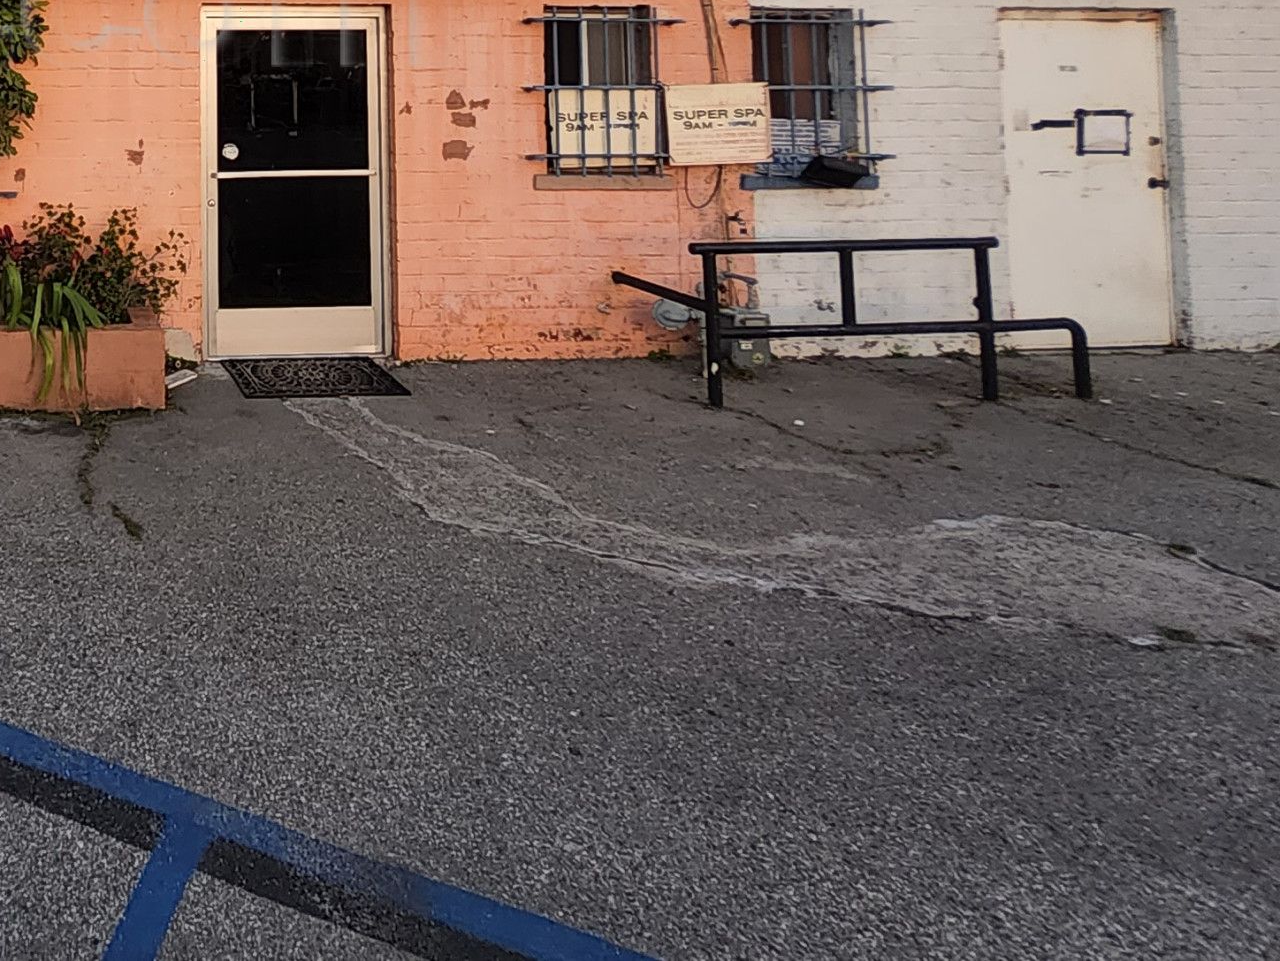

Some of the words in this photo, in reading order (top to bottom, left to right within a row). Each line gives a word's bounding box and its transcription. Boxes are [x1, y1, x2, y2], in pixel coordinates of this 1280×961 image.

[673, 109, 728, 121] SUPER
[733, 108, 765, 119] SPA
[683, 121, 712, 130] 9AM
